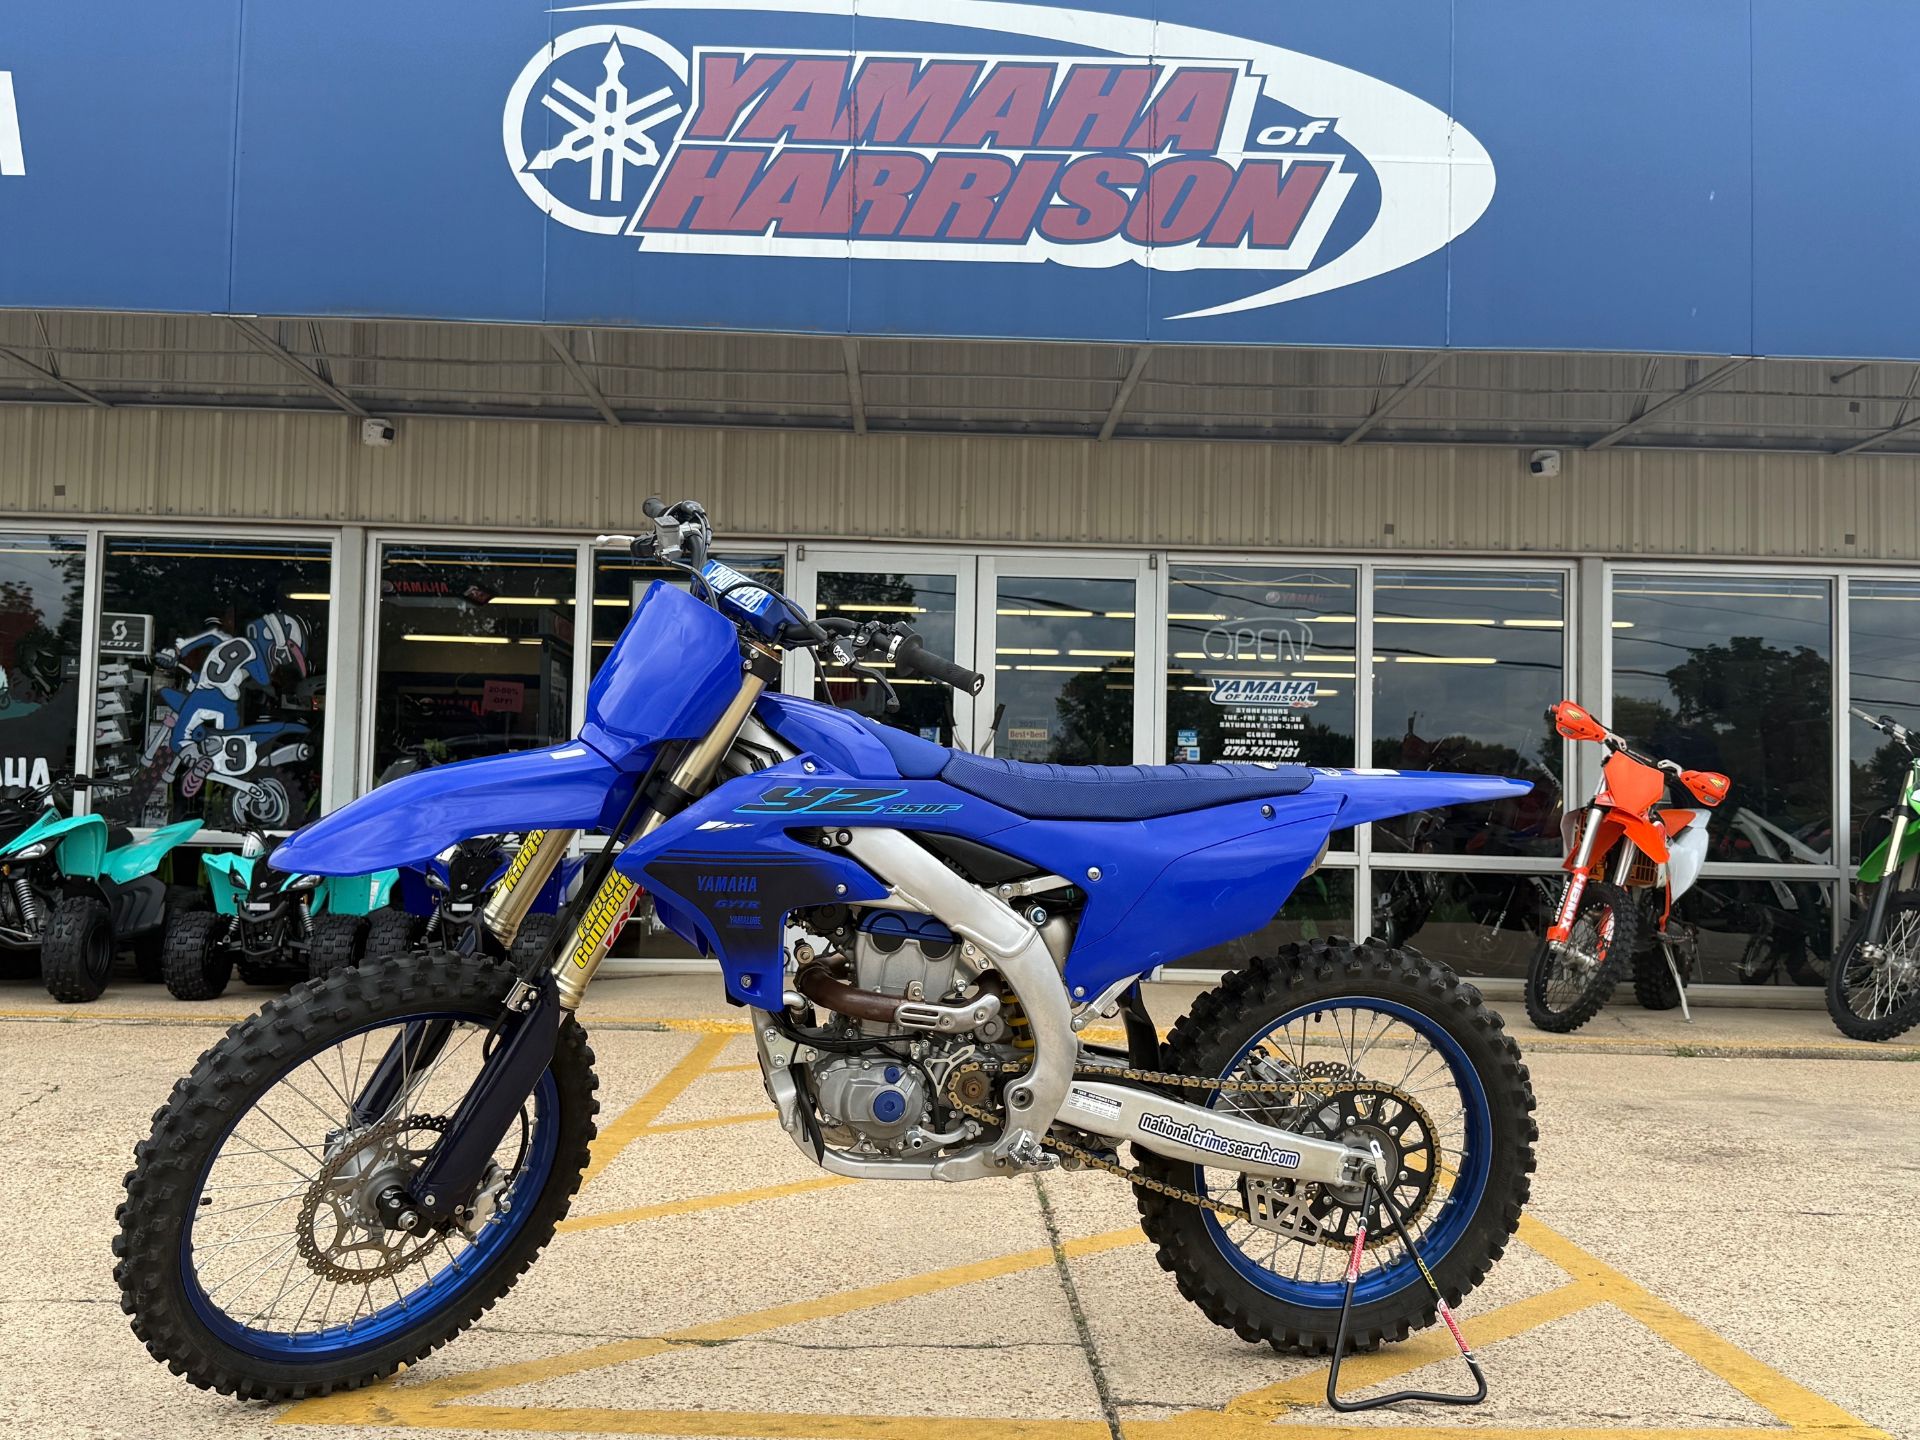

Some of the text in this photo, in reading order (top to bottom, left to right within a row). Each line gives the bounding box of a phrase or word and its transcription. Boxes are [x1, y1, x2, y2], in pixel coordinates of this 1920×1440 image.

[688, 55, 1239, 150] YAMAHA
[1256, 117, 1336, 147] of
[641, 149, 1328, 248] HARRISON
[395, 581, 449, 593] YAMAHA
[1202, 628, 1306, 663] OPEN
[207, 640, 252, 684] 9
[1212, 680, 1317, 695] YAMAHA
[1225, 693, 1307, 702] OF HARRISON
[1219, 721, 1261, 729] SATURDAY
[1246, 731, 1277, 739] CLOSED
[224, 737, 248, 772] 9
[1222, 745, 1301, 758] 870-741-3131
[1224, 738, 1257, 746] SUNDAY
[733, 786, 964, 815] YZ 250F
[697, 875, 758, 893] YAMAHA
[1554, 881, 1571, 923] DUNLOP
[1140, 1114, 1299, 1168] nationalcrimesearch.com
